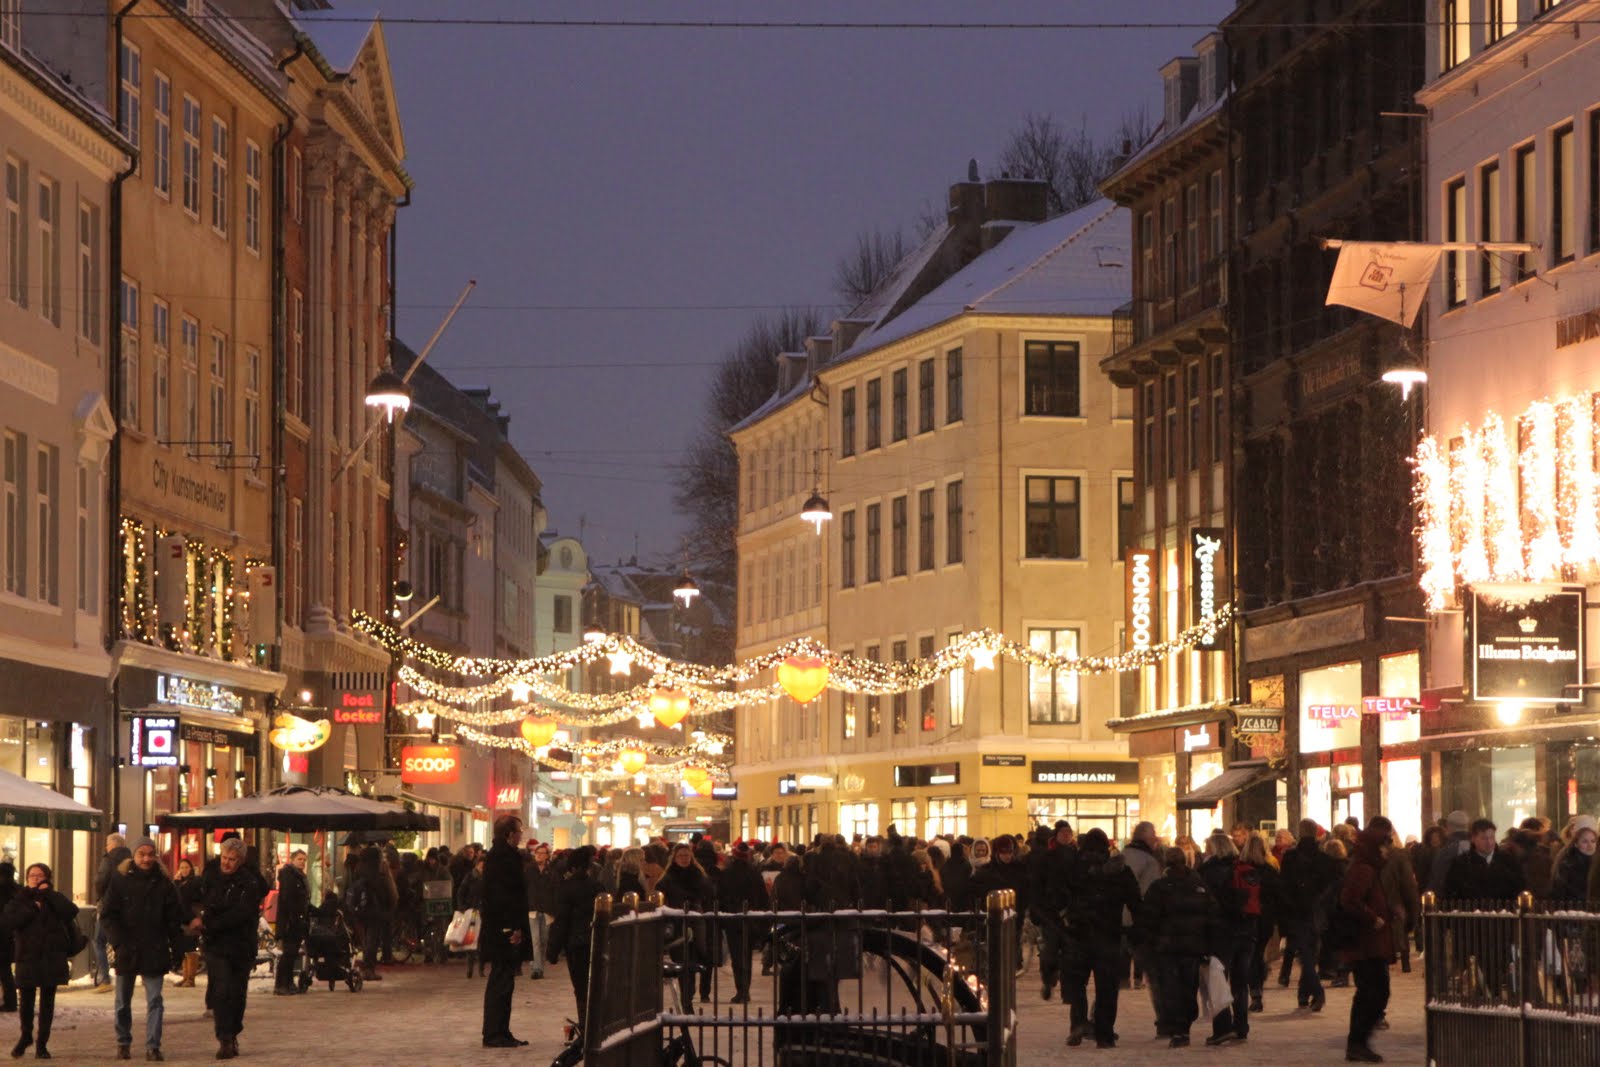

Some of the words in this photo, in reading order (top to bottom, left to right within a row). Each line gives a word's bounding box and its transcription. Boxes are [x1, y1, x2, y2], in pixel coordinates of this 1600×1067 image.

[1479, 644, 1520, 659] Illums
[1521, 645, 1577, 663] Bolighus
[343, 694, 374, 706] Foot
[335, 709, 381, 722] Locker
[1311, 706, 1359, 719] TELIA
[1241, 718, 1278, 729] SCARPA
[405, 758, 456, 772] SCOOP
[1038, 773, 1116, 782] DRESSMANN
